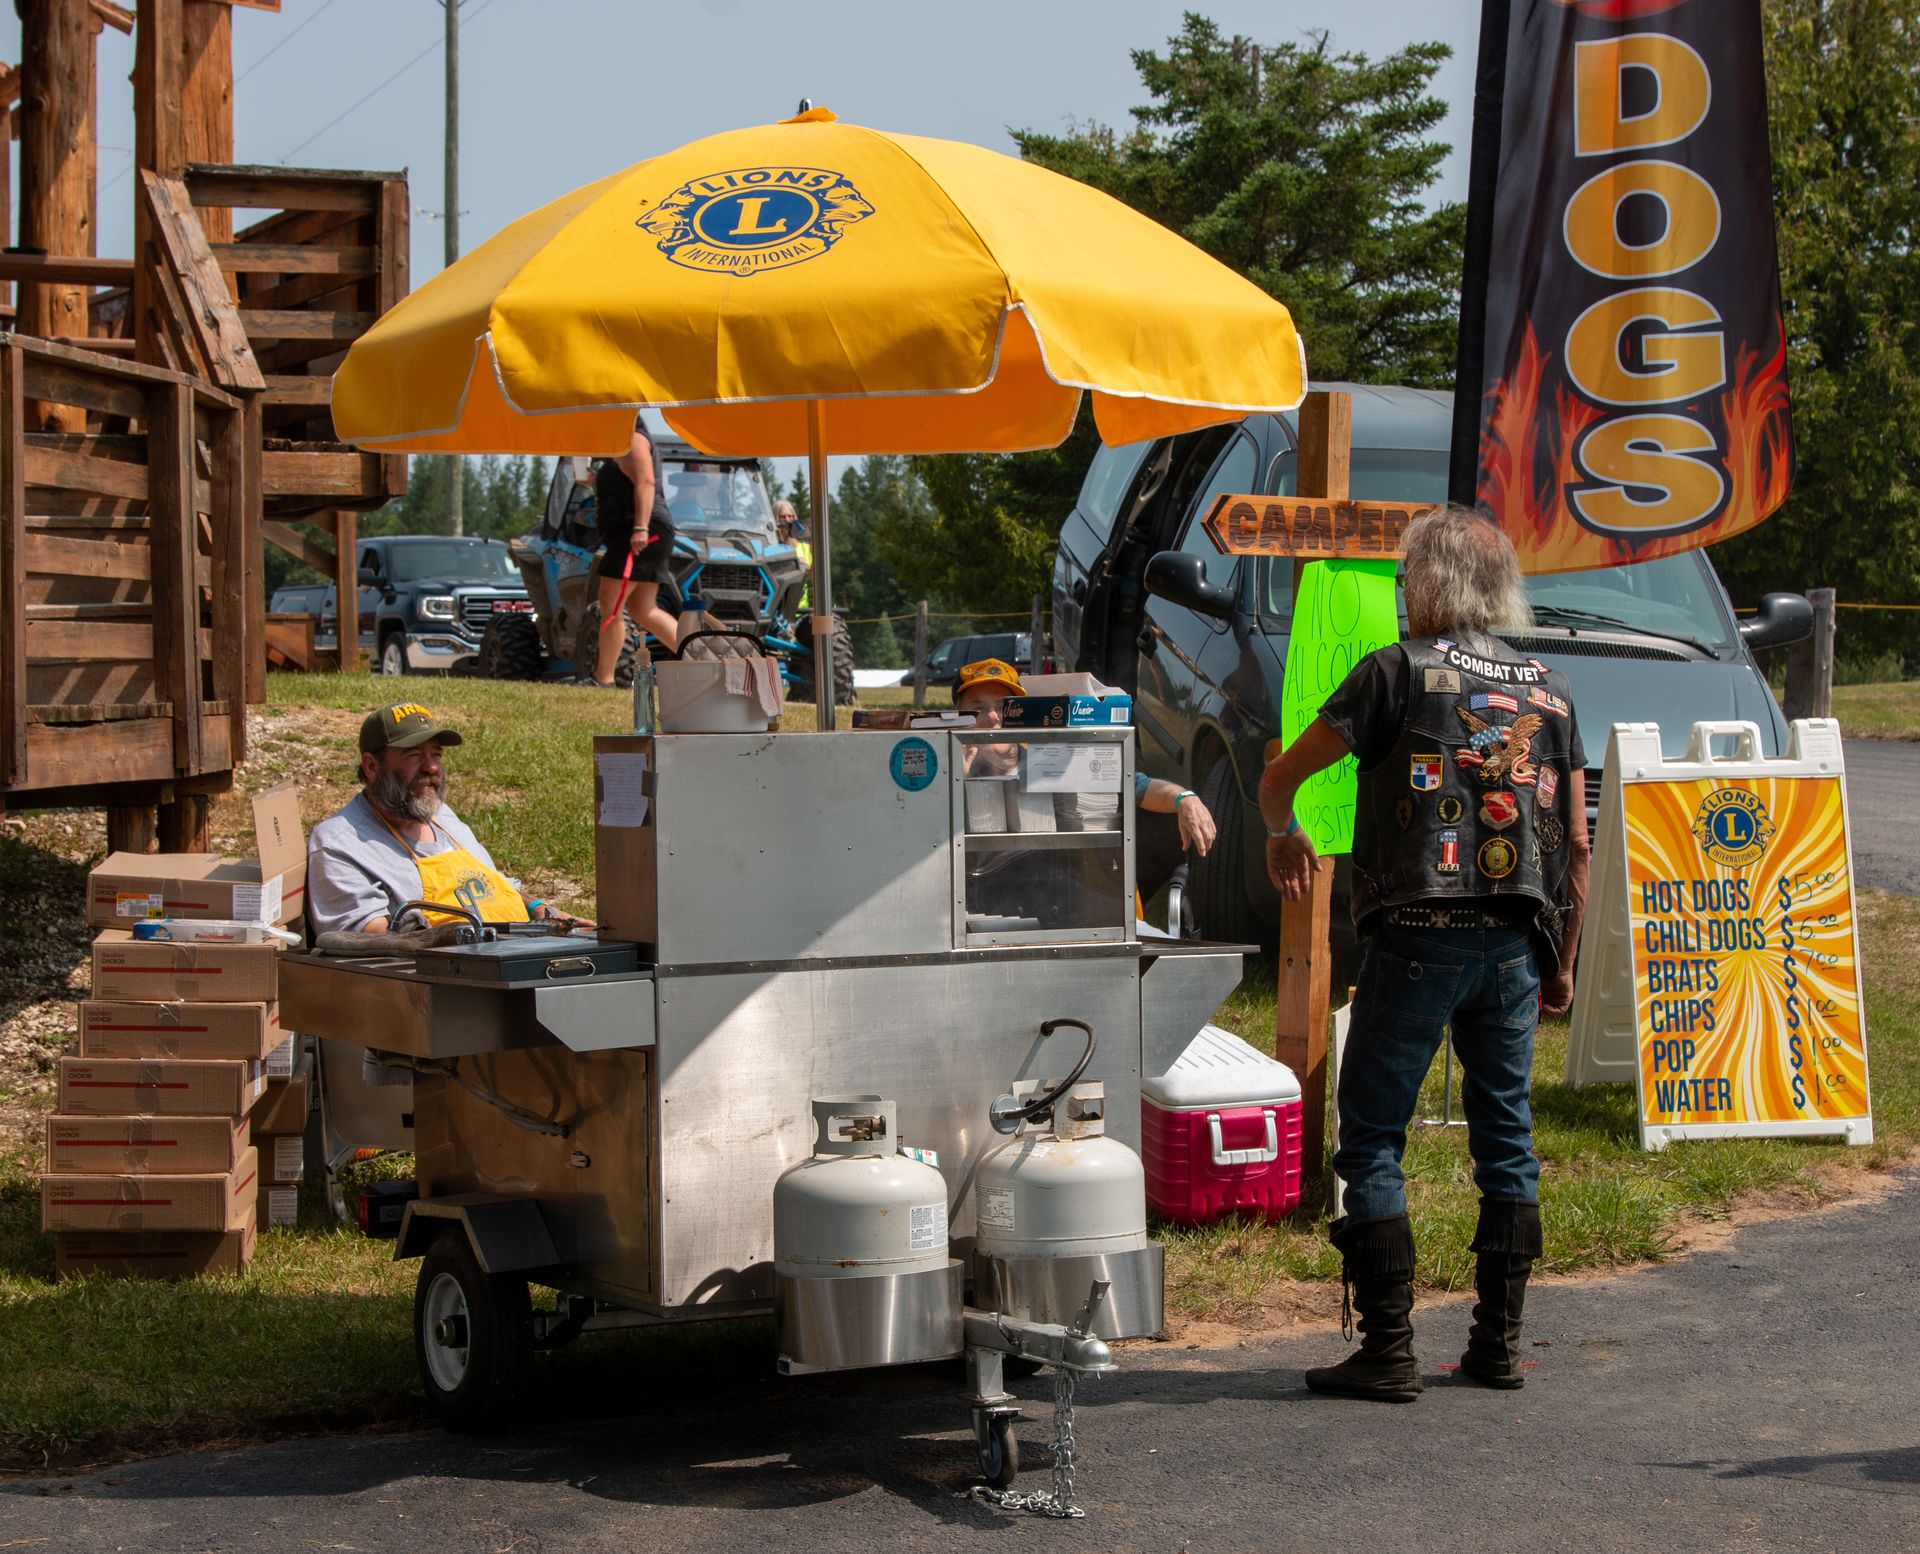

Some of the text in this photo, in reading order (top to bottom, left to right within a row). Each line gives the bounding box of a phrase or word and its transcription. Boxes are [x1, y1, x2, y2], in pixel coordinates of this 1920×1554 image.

[699, 170, 832, 196] LIONS
[728, 196, 788, 236] L
[682, 242, 816, 267] INTERNATIONAL
[1563, 32, 1727, 533] DOGS
[1228, 502, 1433, 552] CAMPER
[1311, 563, 1361, 640] NO
[1286, 639, 1386, 704] ALCO
[1450, 650, 1539, 682] COMBAT VET
[1072, 700, 1095, 716] Junior
[1546, 693, 1568, 710] USA
[1708, 791, 1755, 809] LIONS
[1724, 812, 1747, 841] L
[1440, 863, 1458, 871] USA
[1712, 848, 1759, 863] INTERNATIONAL
[1642, 879, 1685, 914] HOT
[1692, 878, 1750, 913] DOGS
[1778, 875, 1792, 912] $
[1645, 919, 1702, 954] CHILI
[1709, 917, 1766, 951] DOGS
[1781, 915, 1795, 951] $
[1648, 958, 1719, 993] BRATS
[1783, 954, 1798, 990] $
[1650, 998, 1716, 1033] CHIPS
[1786, 994, 1801, 1030] $
[1653, 1039, 1696, 1073] POP
[1789, 1034, 1803, 1070] $
[1655, 1078, 1733, 1113] WATER
[1792, 1074, 1806, 1110] $
